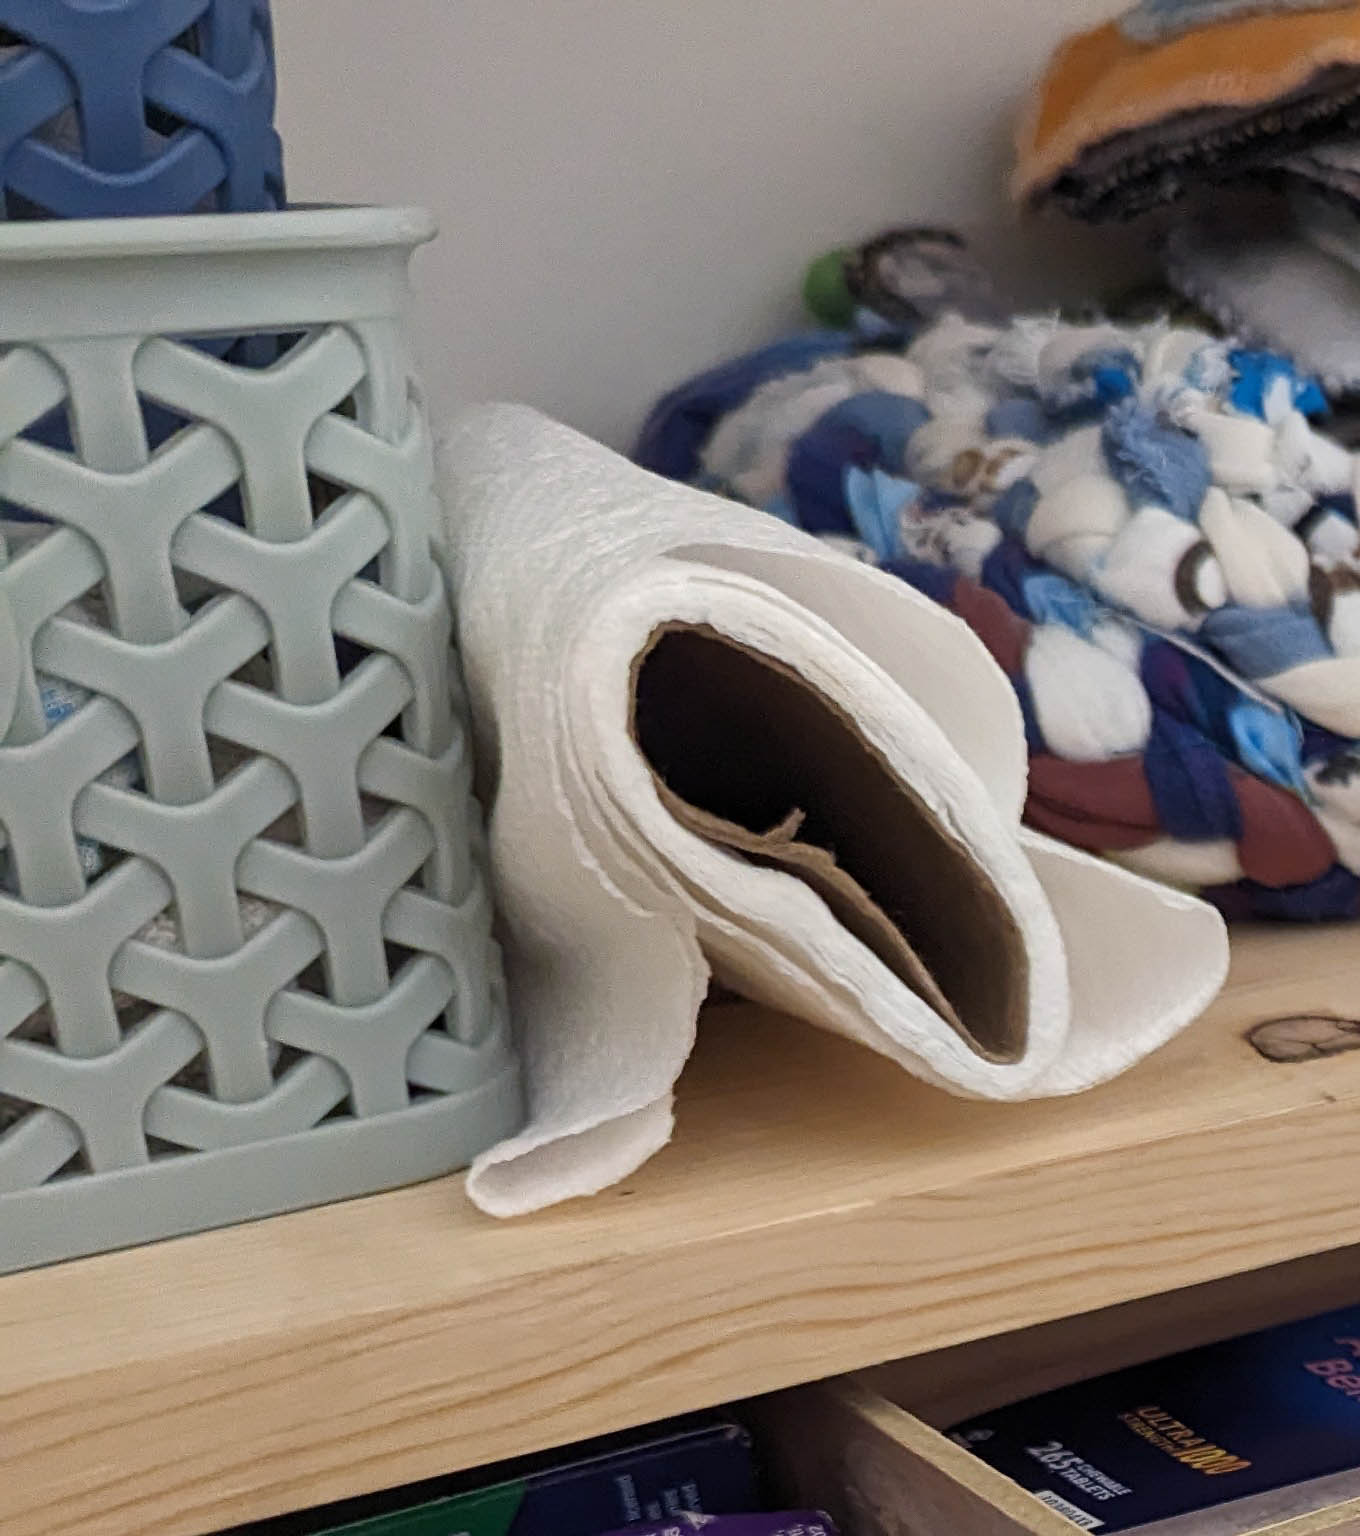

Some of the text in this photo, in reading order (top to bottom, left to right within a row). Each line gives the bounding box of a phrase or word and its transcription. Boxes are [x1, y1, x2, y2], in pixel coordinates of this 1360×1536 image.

[1135, 1405, 1206, 1449] ULTRA
[1025, 1441, 1083, 1471] 265
[1061, 1467, 1115, 1501] TABLETS
